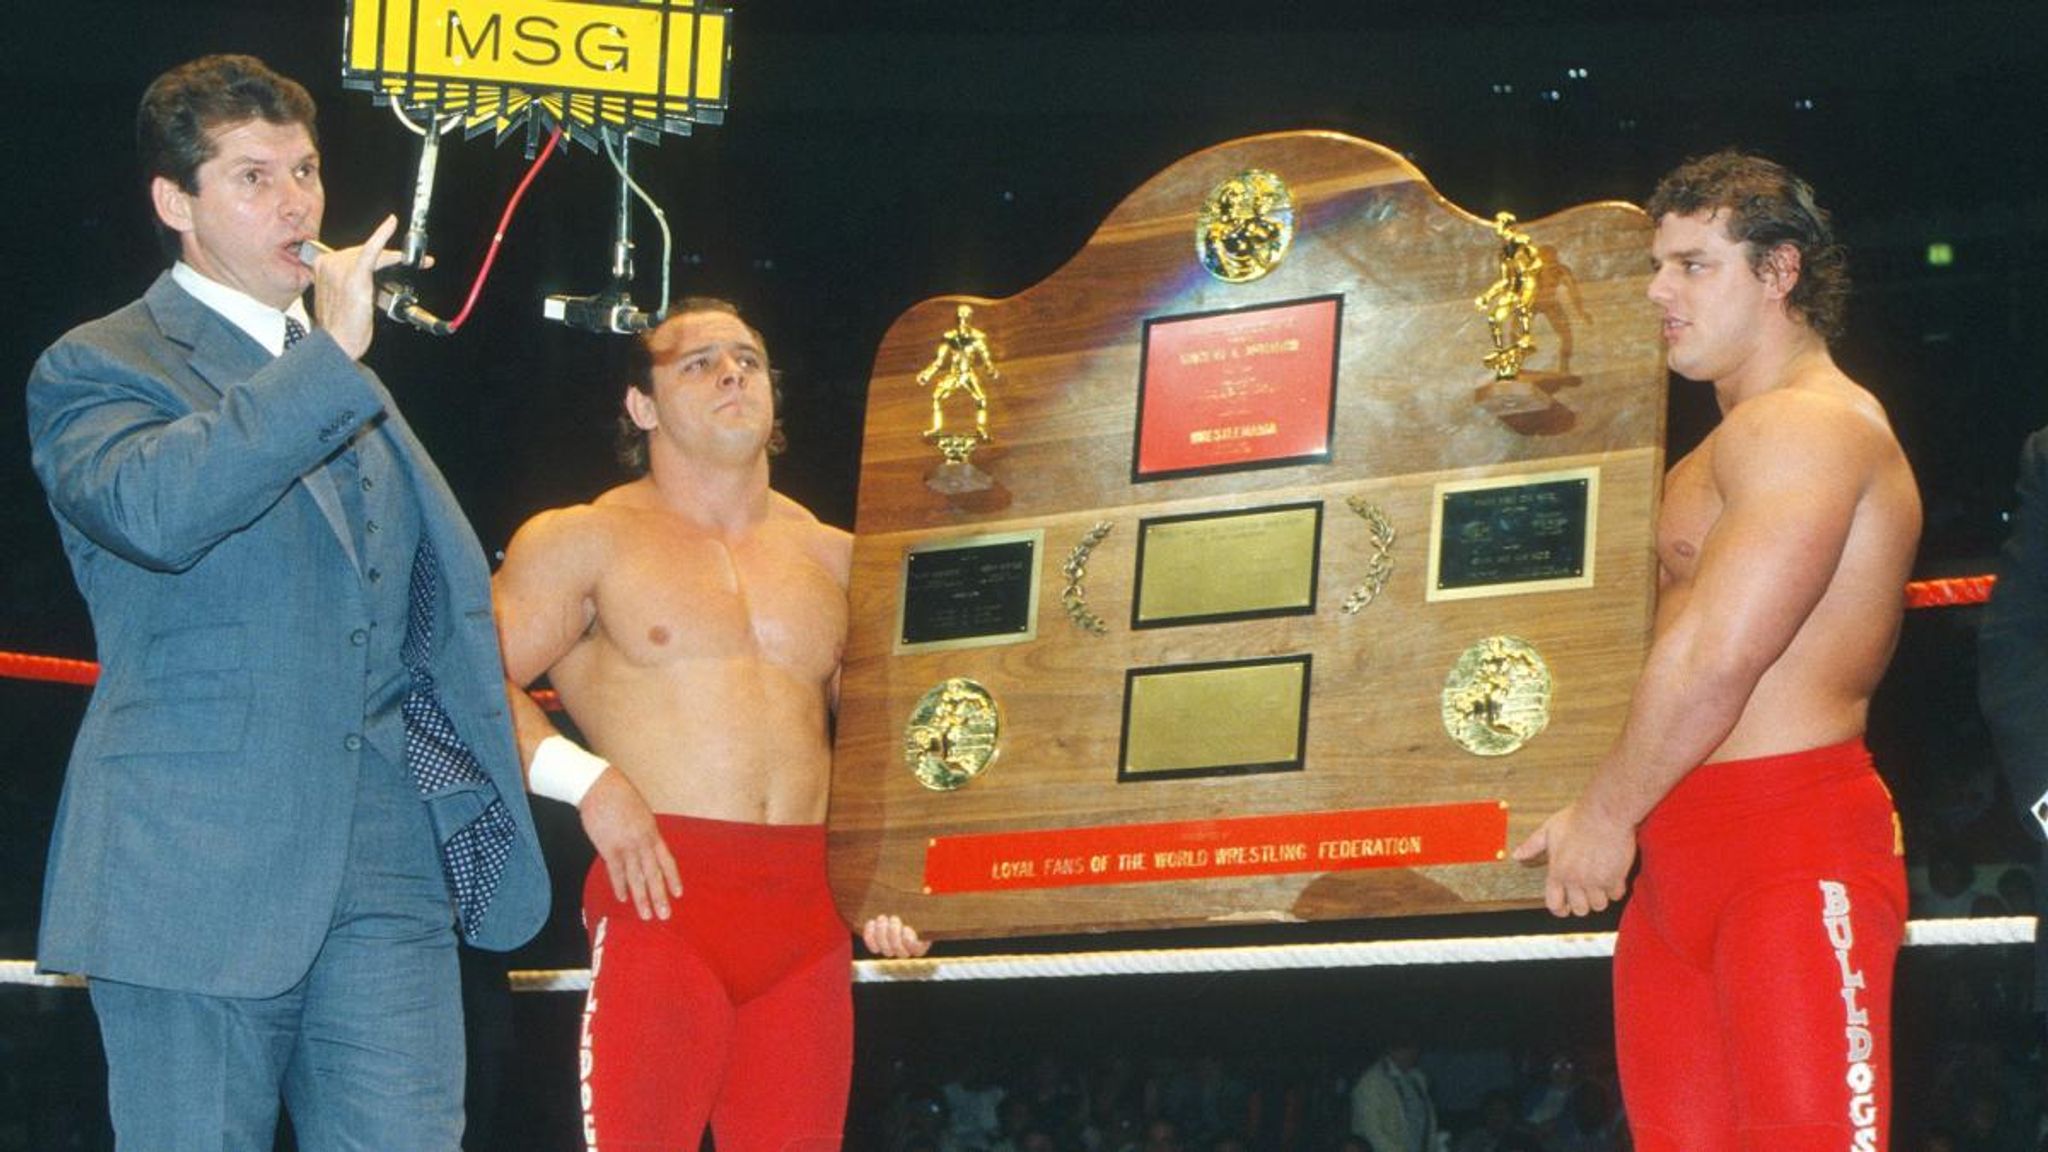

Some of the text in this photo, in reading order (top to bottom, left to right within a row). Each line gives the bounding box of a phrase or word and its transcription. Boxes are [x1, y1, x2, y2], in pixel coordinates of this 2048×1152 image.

[445, 10, 630, 74] MSG
[991, 836, 1422, 880] LOYAL FANS OF THE WORLD WRESTLING FEDERATION
[1818, 879, 1877, 1152] BULLDOGS
